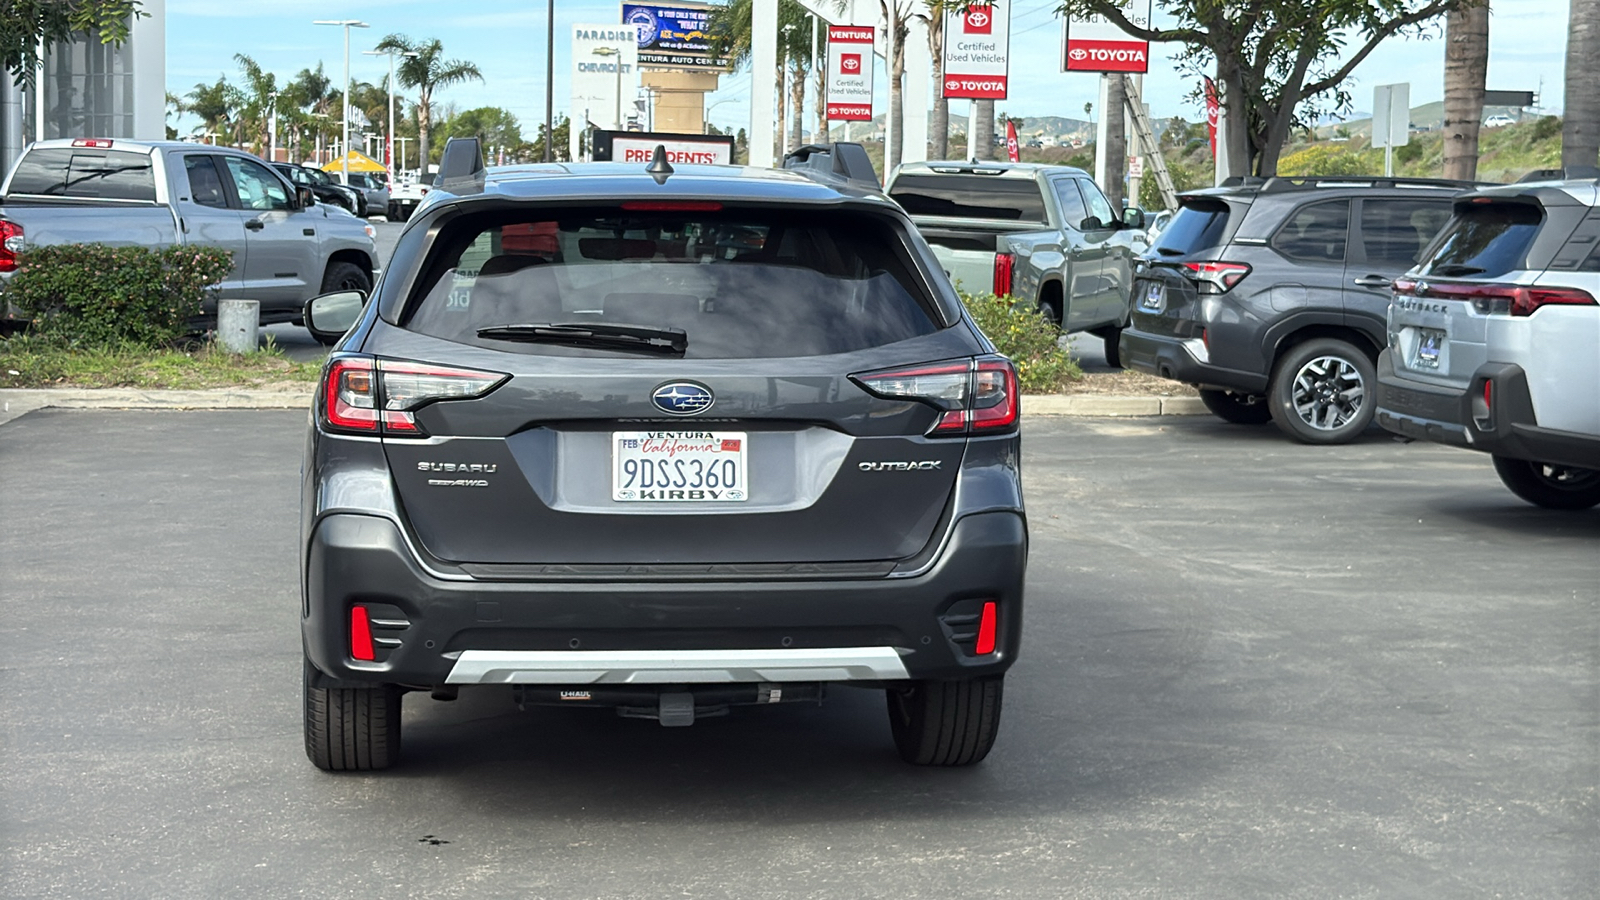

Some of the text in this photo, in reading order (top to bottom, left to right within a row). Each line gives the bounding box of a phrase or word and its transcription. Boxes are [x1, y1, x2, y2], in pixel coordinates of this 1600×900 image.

[576, 29, 634, 42] PARADISE
[660, 30, 672, 38] ACE
[830, 31, 873, 40] VENTURA
[957, 42, 996, 51] Certified
[638, 54, 669, 63] ENTURA
[696, 58, 728, 66] CENER
[946, 54, 1006, 63] Used Vehicles
[1089, 49, 1144, 62] TOYOTA
[578, 63, 631, 74] CHEVROET
[960, 82, 1004, 91] TOYOTA
[625, 150, 716, 164] PREDENTS'
[1400, 301, 1448, 314] OUTBACK
[623, 440, 638, 448] FEB
[642, 439, 722, 458] California
[418, 462, 496, 472] SUBARU
[858, 460, 941, 471] OUTBACK
[623, 459, 736, 488] 9DSS360
[640, 490, 723, 500] KIRBY
